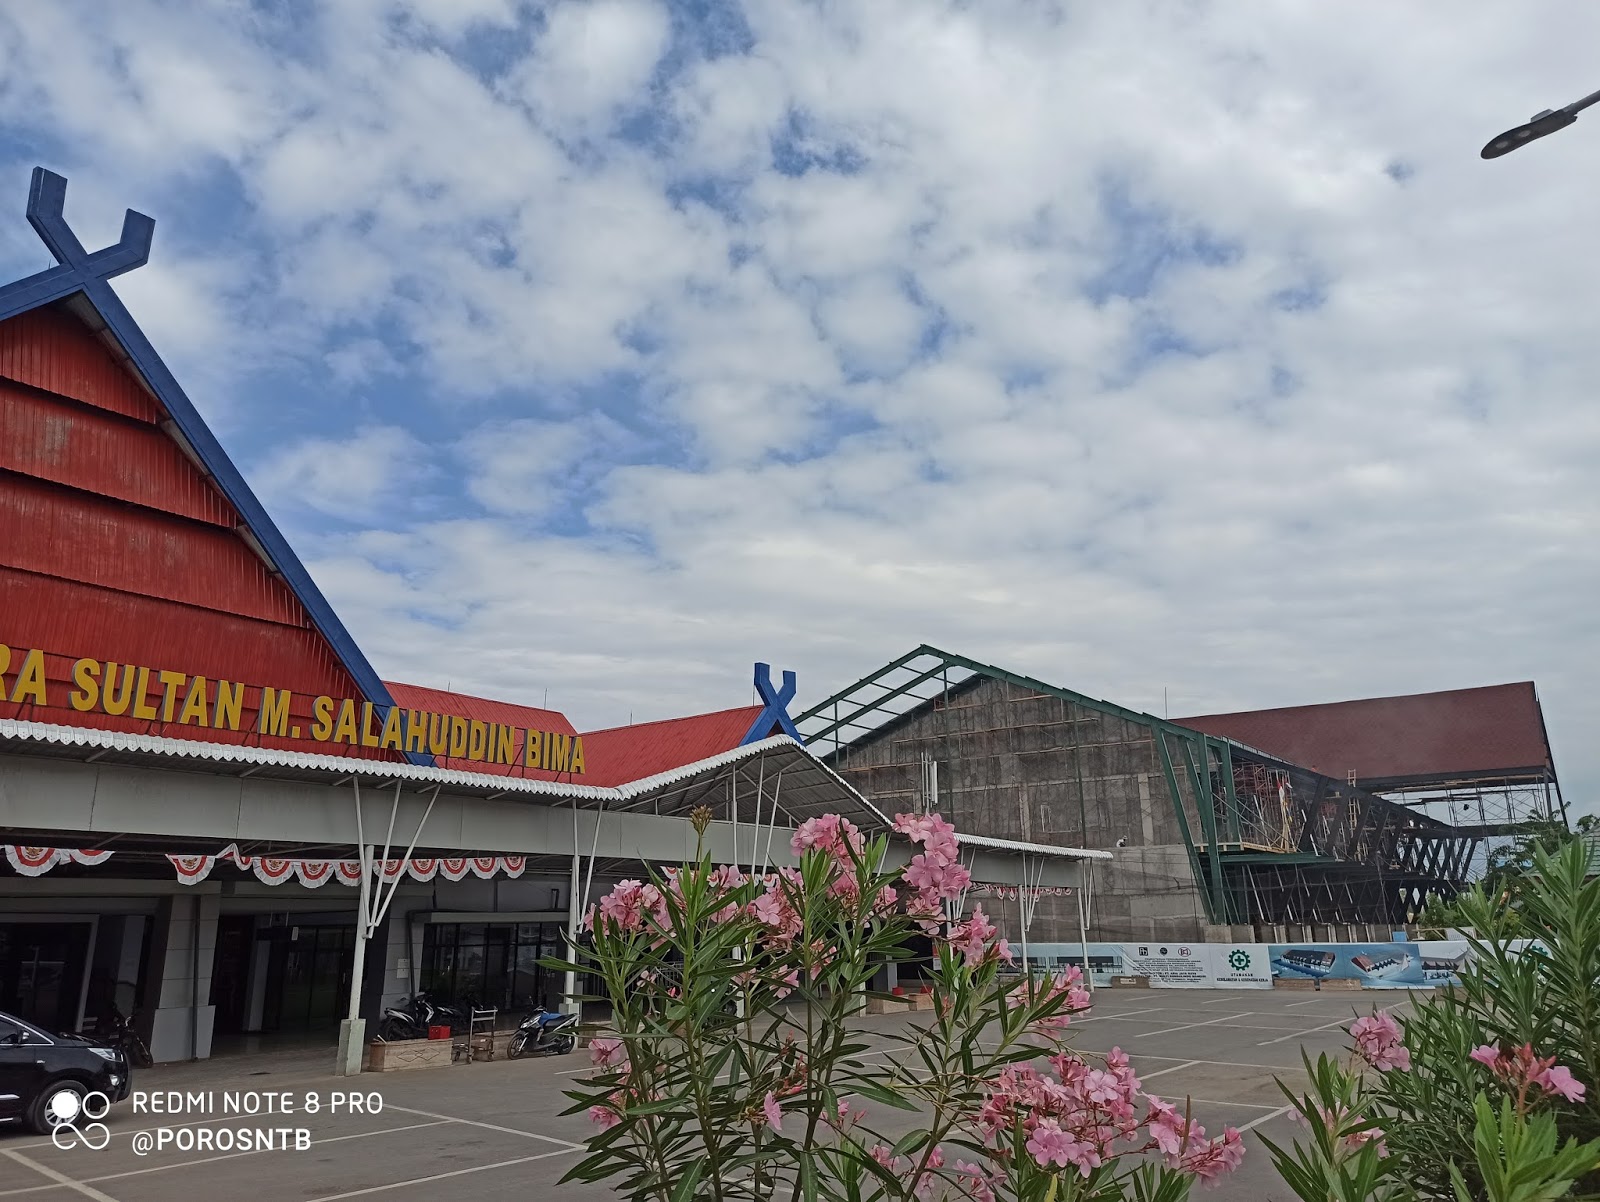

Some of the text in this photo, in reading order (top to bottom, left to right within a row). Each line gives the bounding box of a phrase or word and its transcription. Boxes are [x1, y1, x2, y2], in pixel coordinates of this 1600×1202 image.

[70, 658, 244, 731] SULTAN
[259, 686, 301, 739] M.
[310, 695, 515, 766] SALAHUDDIN
[524, 728, 586, 774] BIMA
